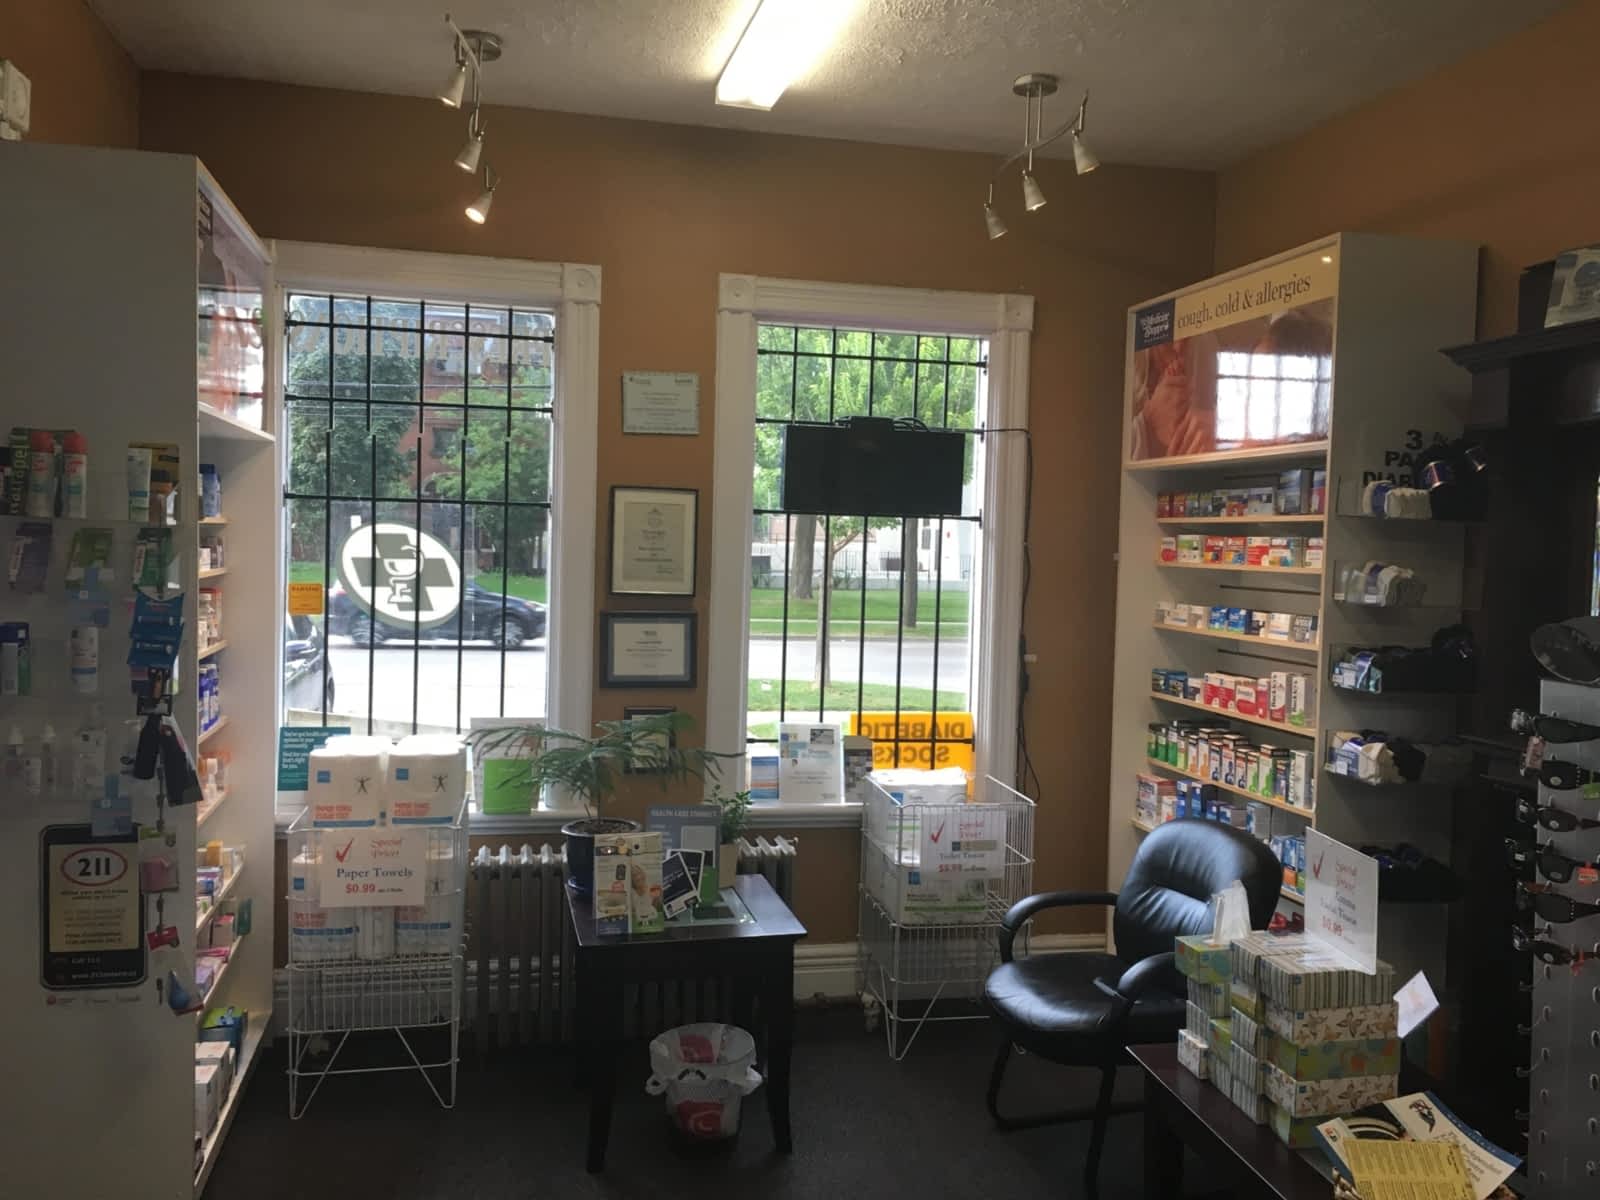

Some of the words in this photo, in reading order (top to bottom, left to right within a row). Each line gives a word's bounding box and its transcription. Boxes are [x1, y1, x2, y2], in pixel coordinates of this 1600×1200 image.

[1177, 302, 1213, 329] cough,
[1215, 295, 1240, 318] cold
[1241, 291, 1254, 309] &
[1255, 273, 1311, 304] allergies
[1405, 430, 1423, 450] 3
[77, 857, 111, 877] 211
[336, 867, 369, 881] Paper
[373, 867, 413, 878] Towels
[345, 882, 376, 894] $0.99
